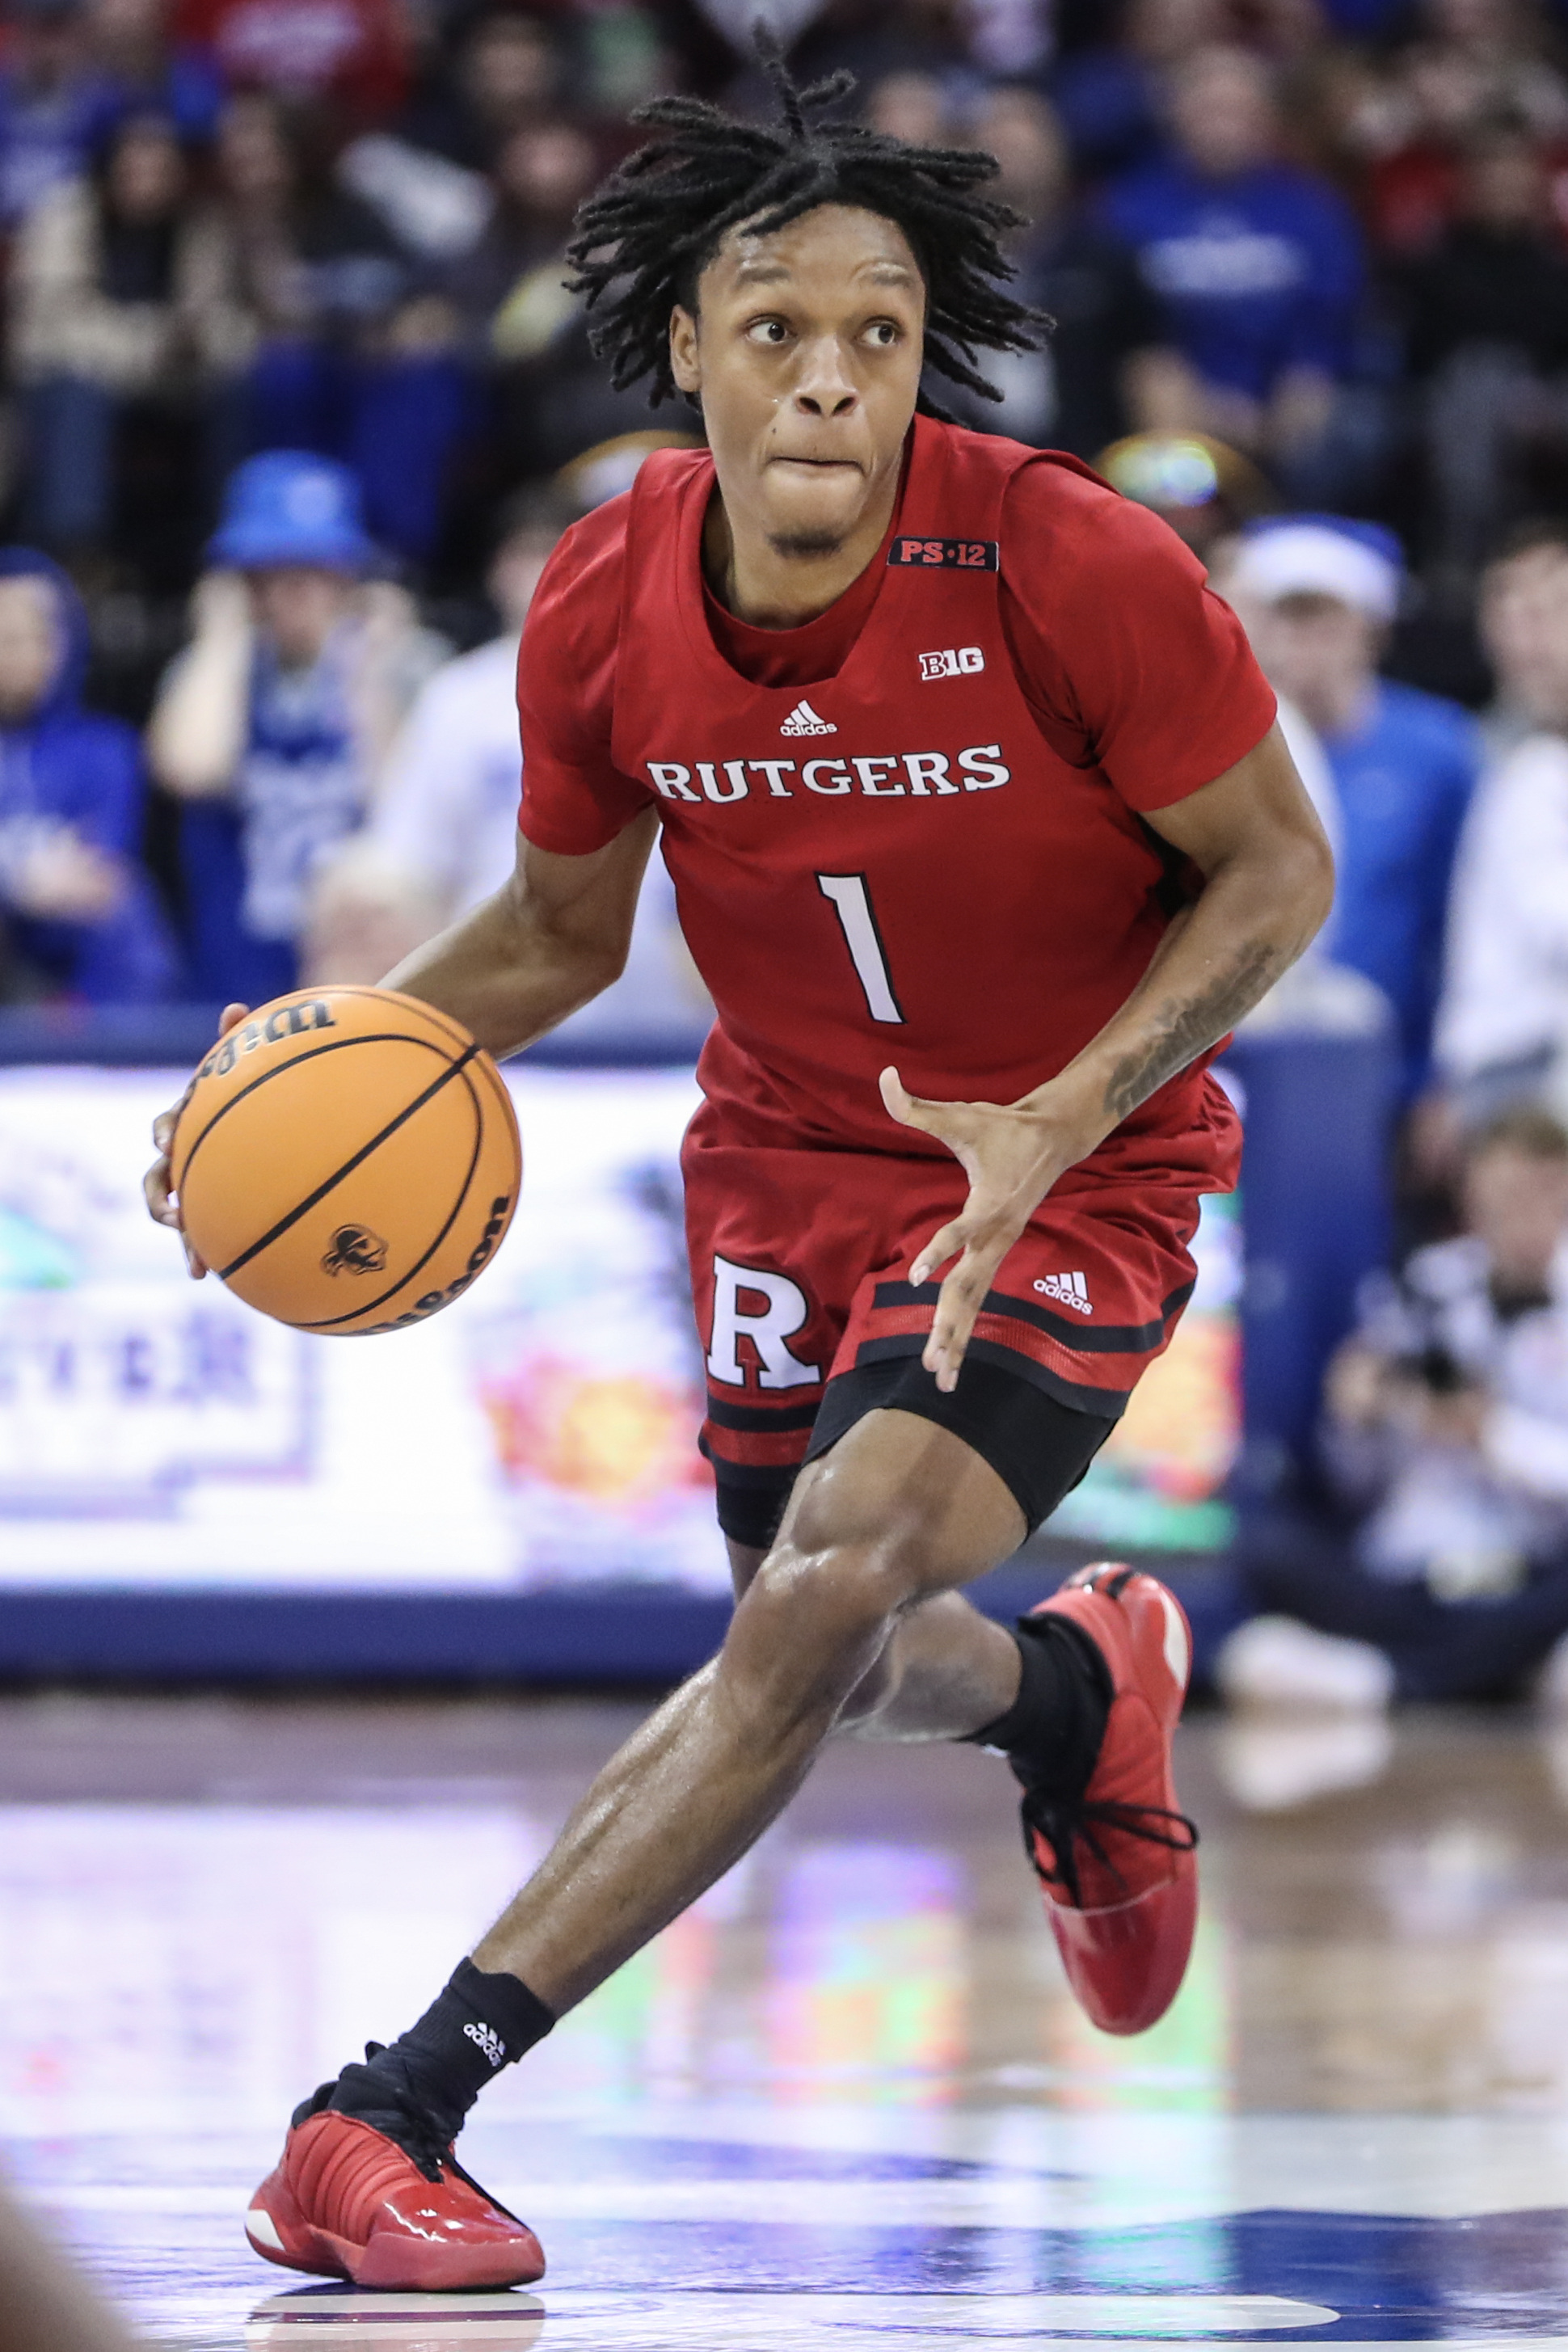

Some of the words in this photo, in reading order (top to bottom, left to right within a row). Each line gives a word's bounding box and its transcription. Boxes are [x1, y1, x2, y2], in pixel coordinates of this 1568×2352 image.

[779, 721, 838, 737] adidas
[646, 743, 1012, 803] RUTGERS
[815, 872, 907, 1024] 1
[184, 999, 335, 1104] Wils
[706, 1254, 821, 1389] R
[1033, 1277, 1094, 1316] adidas
[462, 2023, 502, 2067] adidas
